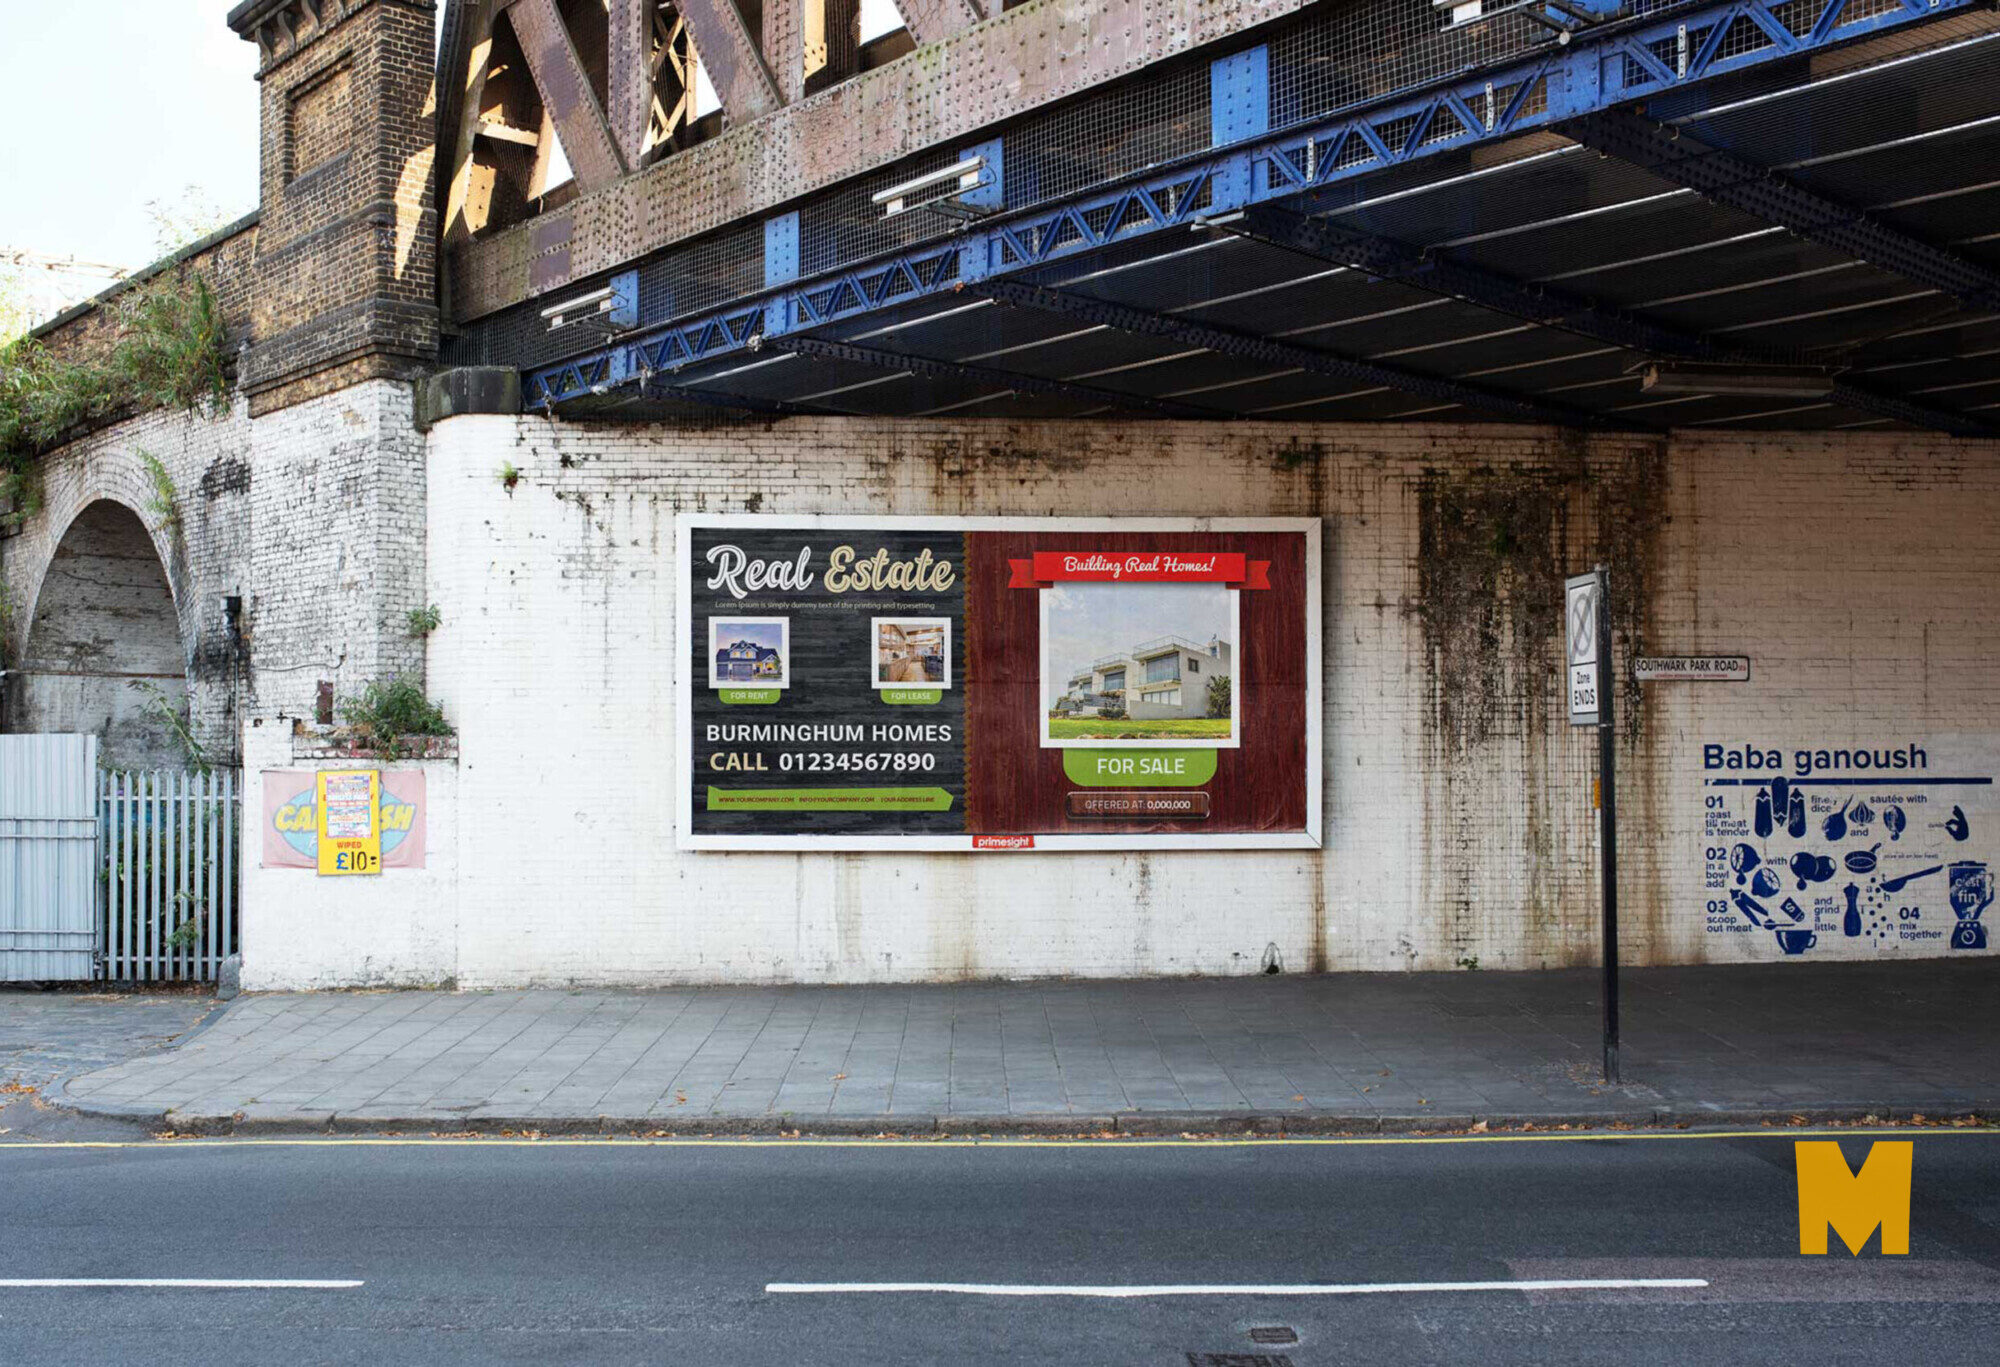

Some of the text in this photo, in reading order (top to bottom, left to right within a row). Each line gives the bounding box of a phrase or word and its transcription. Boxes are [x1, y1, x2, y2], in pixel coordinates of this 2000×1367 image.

[1063, 555, 1216, 578] Building Real Homes!
[706, 545, 955, 599] Real Estate
[1636, 660, 1686, 671] SOUTHWARK
[1690, 660, 1711, 671] PARK
[1714, 660, 1738, 671] ROAD
[1576, 671, 1590, 684] Zone
[730, 692, 769, 700] FOR RENT
[891, 692, 931, 700] FOR LEASE
[1574, 689, 1595, 706] ENDS
[707, 725, 952, 742] BURMINGHUM HOMES
[710, 752, 935, 771] CALL 01234567890
[1704, 743, 1927, 776] Baba ganoush
[1097, 758, 1185, 774] FOR SALE
[1705, 796, 1724, 808] 01
[1906, 795, 1927, 803] with
[1085, 801, 1129, 809] OFFERED
[1147, 801, 1191, 811] 0,000,000
[1705, 811, 1731, 819] roast
[1705, 819, 1717, 828] till
[1705, 828, 1750, 836] is tender
[1850, 828, 1869, 836] and
[337, 841, 362, 849] WIPED
[978, 837, 1029, 848] primesight
[1706, 848, 1727, 860] 02
[1706, 862, 1716, 870] in
[1766, 857, 1787, 865] with
[1706, 871, 1729, 879] bowl
[1706, 880, 1725, 888] add
[1814, 897, 1833, 905] and
[1958, 890, 1977, 903] fin
[1706, 900, 1728, 913] 03
[1814, 904, 1840, 915] grind
[1899, 907, 1920, 920] 04
[1707, 916, 1737, 925] scoop
[1707, 924, 1753, 932] out meat
[1815, 923, 1837, 931] little
[1900, 922, 1917, 930] mix
[1900, 930, 1942, 940] together
